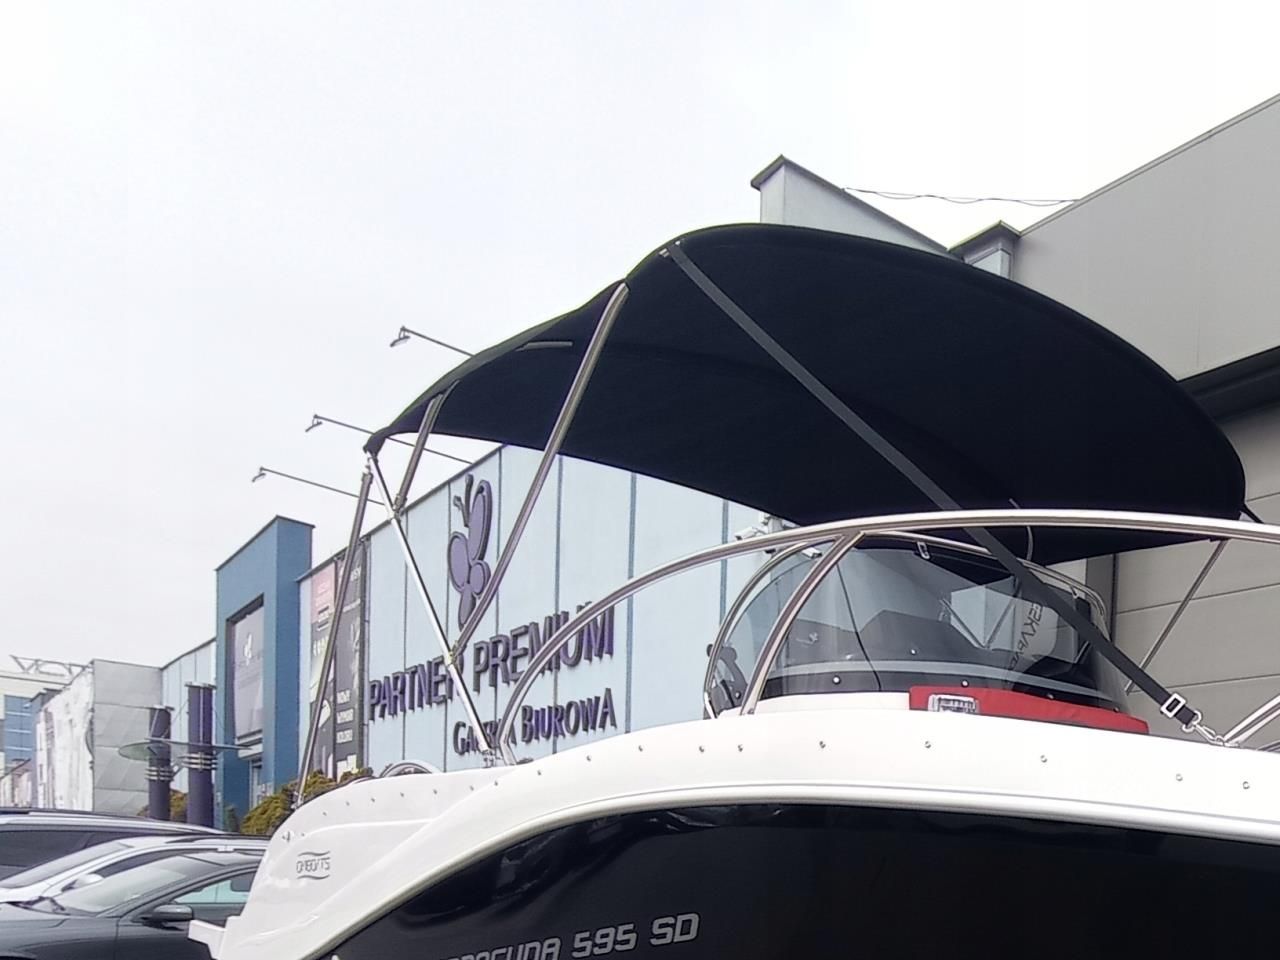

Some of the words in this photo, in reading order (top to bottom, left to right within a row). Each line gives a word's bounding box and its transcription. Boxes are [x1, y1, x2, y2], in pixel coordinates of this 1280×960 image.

[473, 602, 616, 693] PREMIUM
[521, 687, 618, 744] BIUROWA
[571, 923, 638, 959] 595
[650, 912, 700, 946] SD
